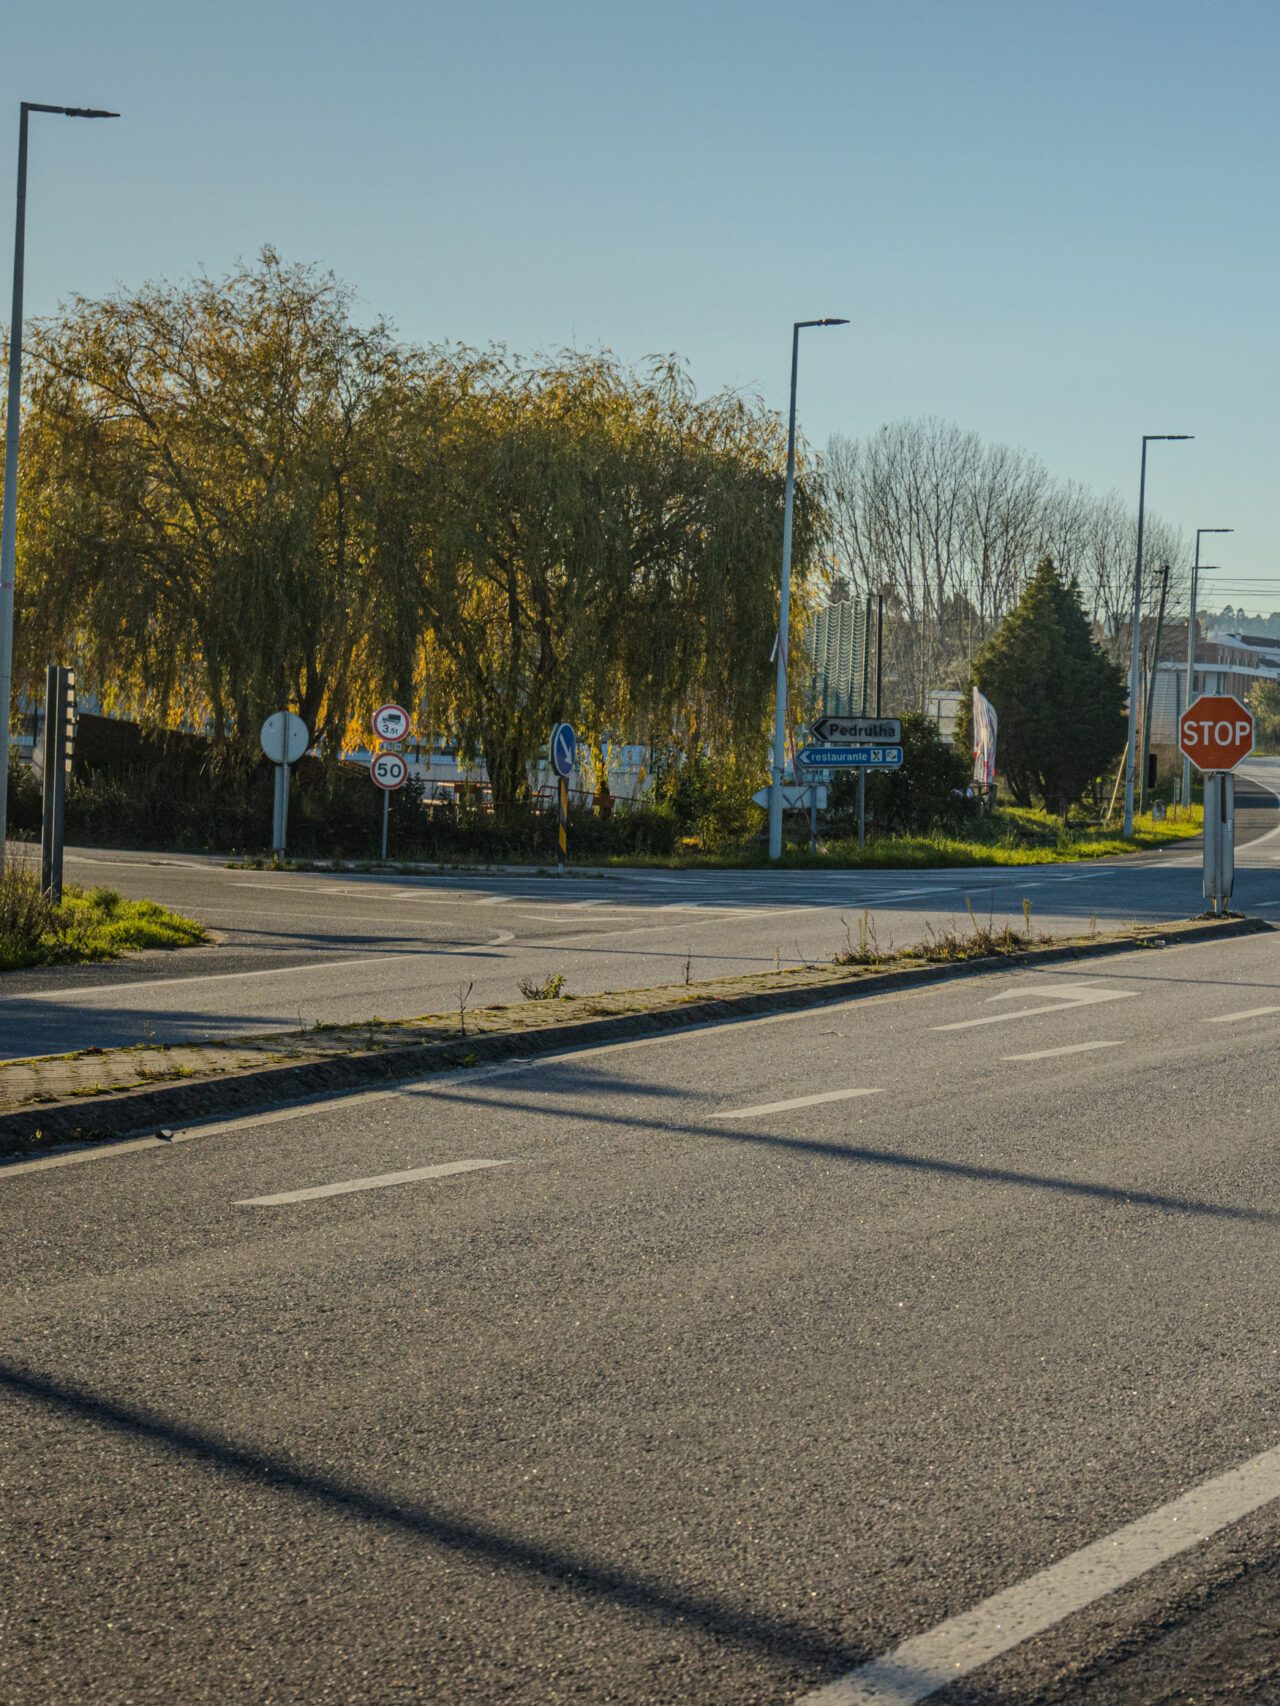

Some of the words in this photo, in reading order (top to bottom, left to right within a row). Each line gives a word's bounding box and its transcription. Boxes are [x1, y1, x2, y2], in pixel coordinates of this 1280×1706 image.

[830, 724, 896, 737] Pedrulha
[1183, 720, 1251, 746] STOP
[811, 752, 868, 762] restaurante
[377, 763, 402, 778] 50
